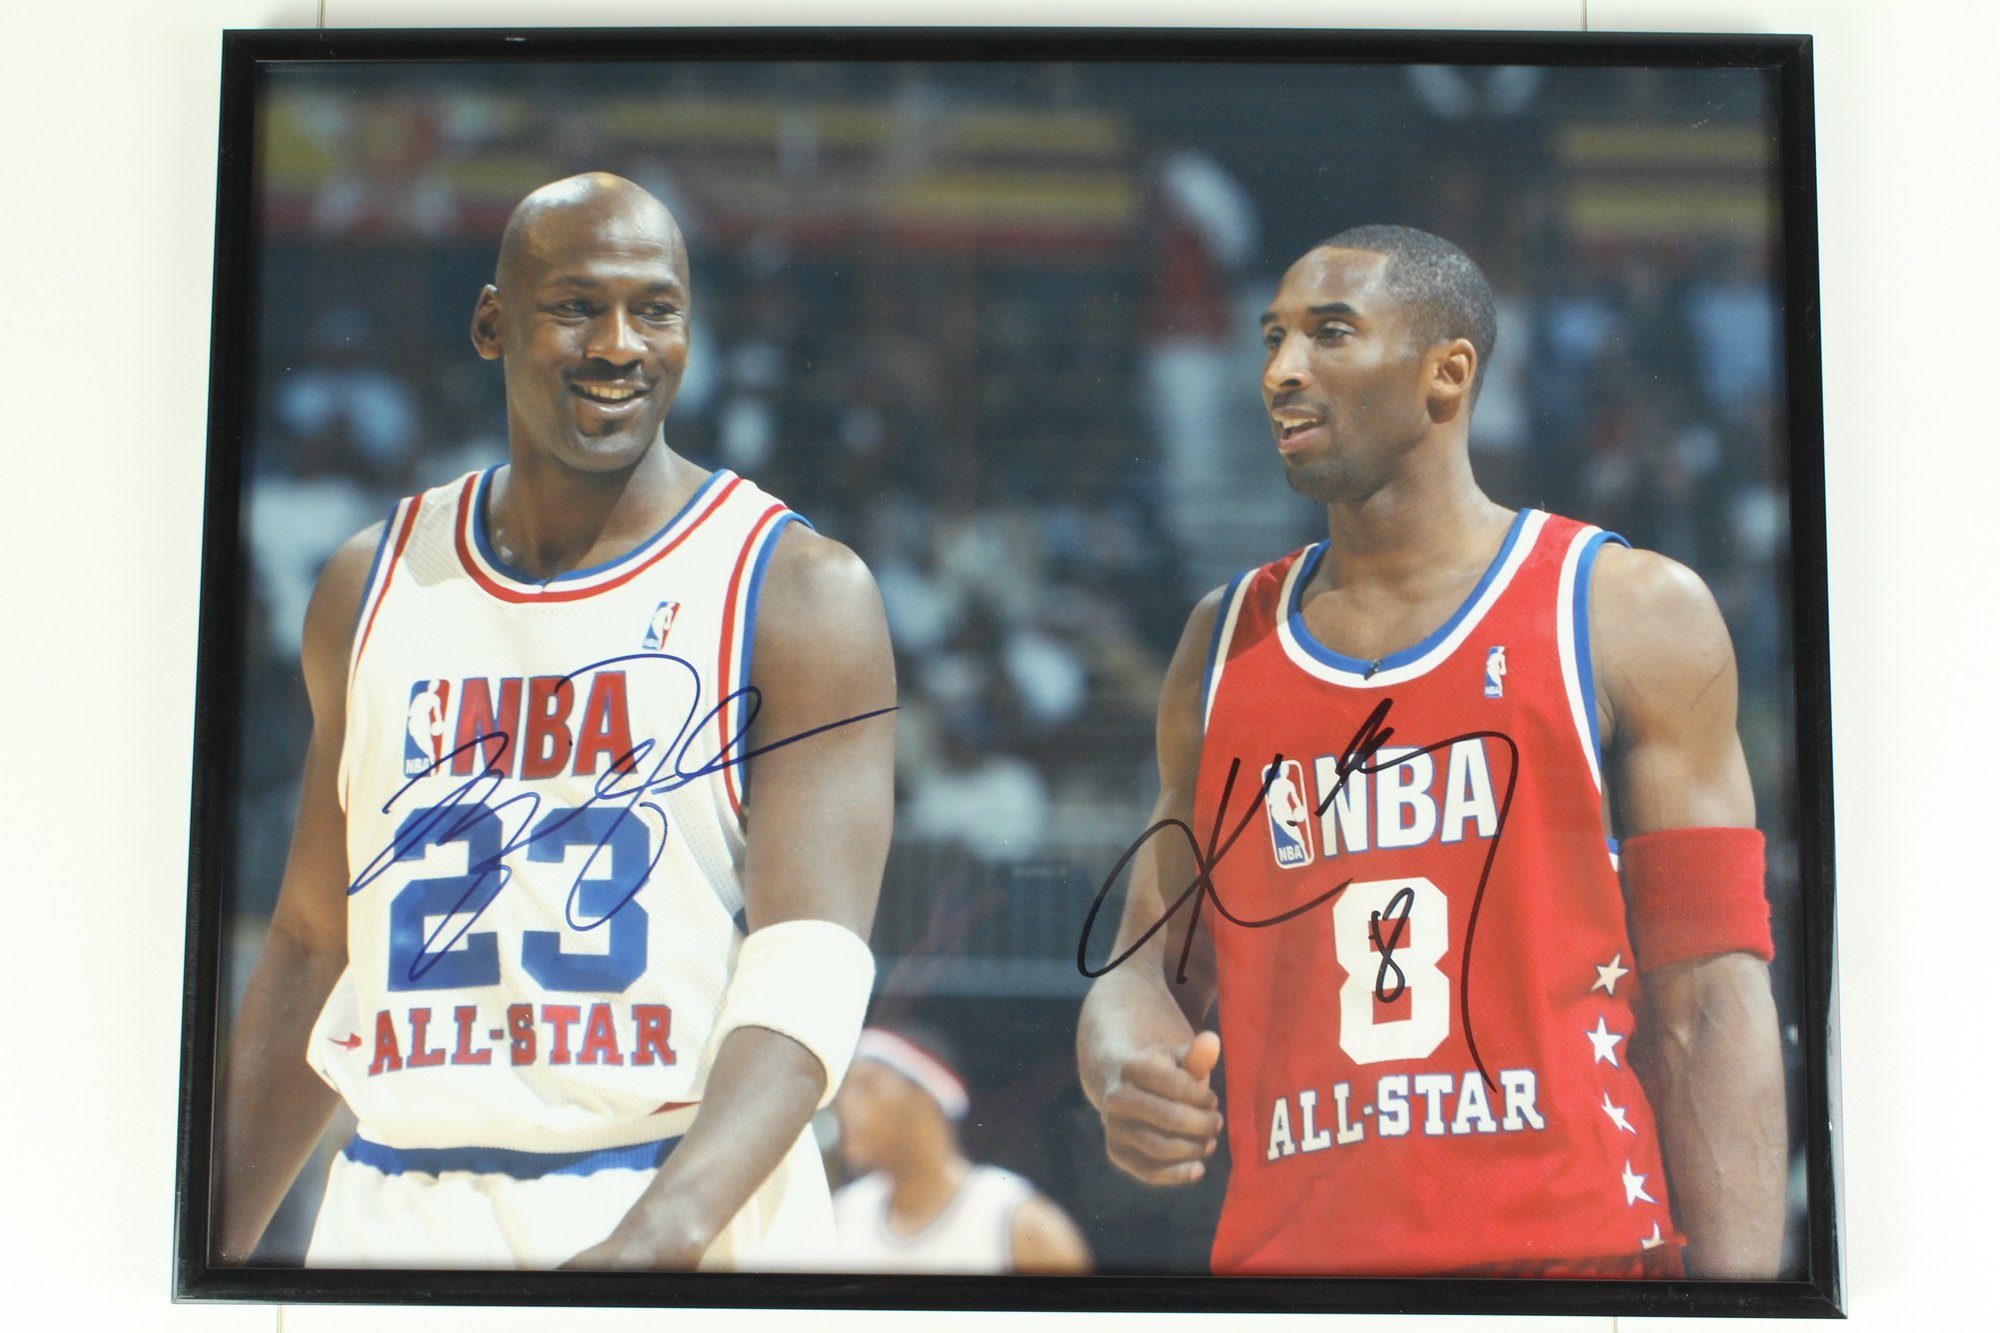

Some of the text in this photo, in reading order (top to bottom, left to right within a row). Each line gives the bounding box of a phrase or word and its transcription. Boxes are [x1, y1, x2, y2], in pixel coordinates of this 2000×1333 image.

[449, 670, 640, 781] NBA
[1312, 736, 1502, 858] NBA
[387, 801, 651, 993] 23
[1278, 845, 1304, 862] NBA
[1332, 876, 1450, 1065] 8
[367, 1002, 677, 1077] ALL-STAR
[1267, 1068, 1545, 1161] ALL-STAR
